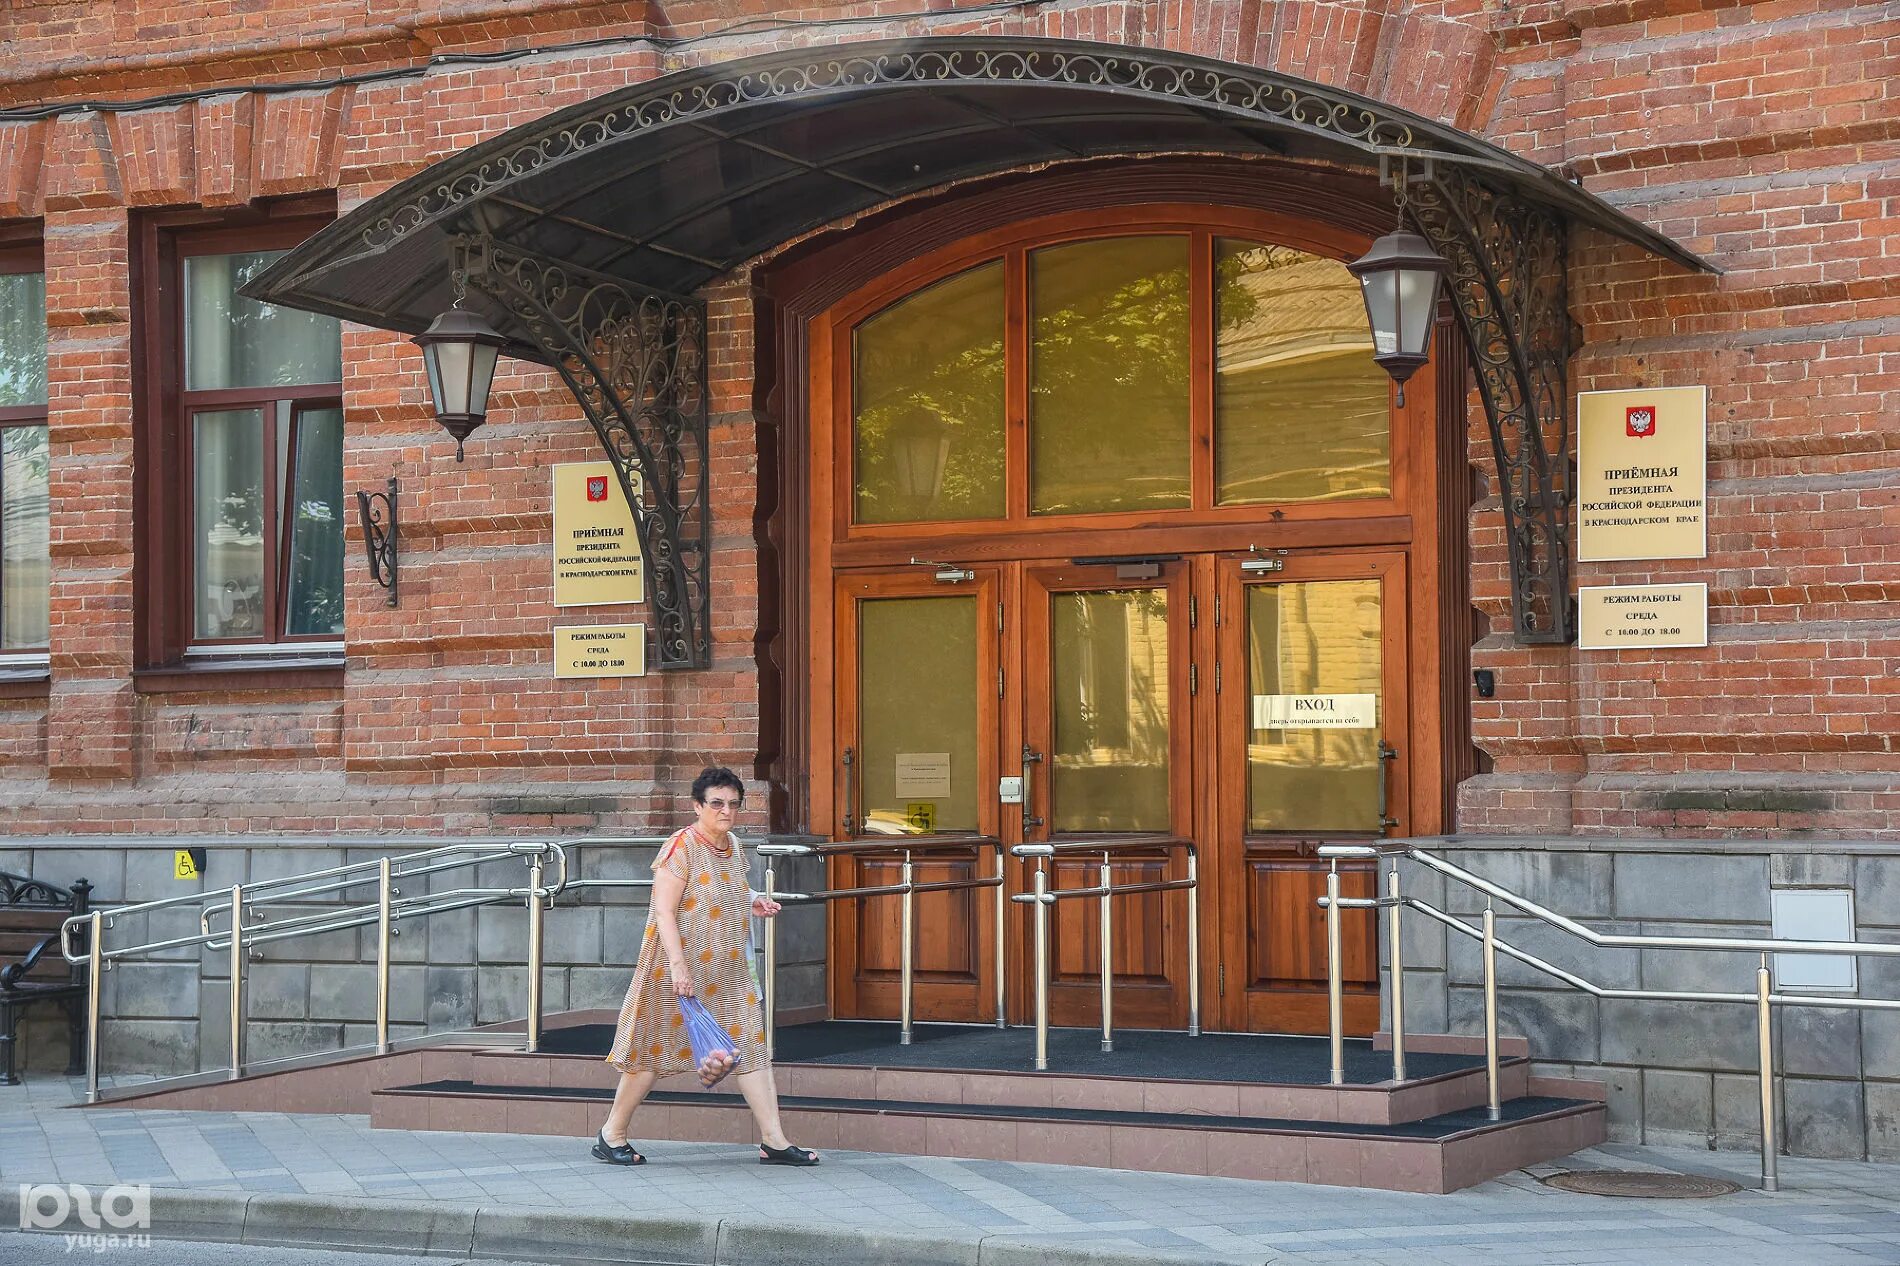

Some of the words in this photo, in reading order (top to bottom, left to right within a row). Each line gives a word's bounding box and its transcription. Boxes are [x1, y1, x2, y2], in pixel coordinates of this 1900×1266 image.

[1604, 464, 1679, 481] ПРИЁМНАЯ
[1609, 485, 1673, 496] ПРЕЗИДЕНТА
[1582, 500, 1643, 512] РОССИЙСКОЙ
[1646, 499, 1702, 510] ФЕДЕРАЦИИ
[1584, 519, 1590, 527] В
[1592, 516, 1670, 527] КРАСНОДАРСКОМ
[1676, 515, 1699, 524] КРАЕ
[573, 526, 624, 539] ПРИЁМНАЯ
[576, 543, 621, 552] ПРЕЗИДЕНТА
[558, 555, 602, 565] РОССИЙСКОЙ
[602, 554, 641, 564] ФЕДЕРАЦИИ
[565, 569, 621, 579] КРАСНОДАРСКОМ
[621, 568, 638, 577] КРАЕ
[1603, 596, 1640, 605] РЕЖИМ
[1642, 594, 1681, 604] РАБОТЫ
[1626, 612, 1658, 621] СРЕДА
[571, 633, 598, 641] РЕЖИМ
[598, 632, 626, 640] РАБОТЫ
[1605, 629, 1612, 637] С
[1641, 628, 1655, 637] ДО
[1660, 627, 1680, 636] 18.00
[587, 647, 610, 655] СРЕДА
[573, 660, 579, 668] С
[581, 660, 597, 668] 10.00
[598, 660, 608, 669] ДО
[610, 659, 625, 667] 18.00
[1295, 698, 1335, 712] ВХОД
[1269, 718, 1289, 726] дверь
[1290, 718, 1334, 726] открывается
